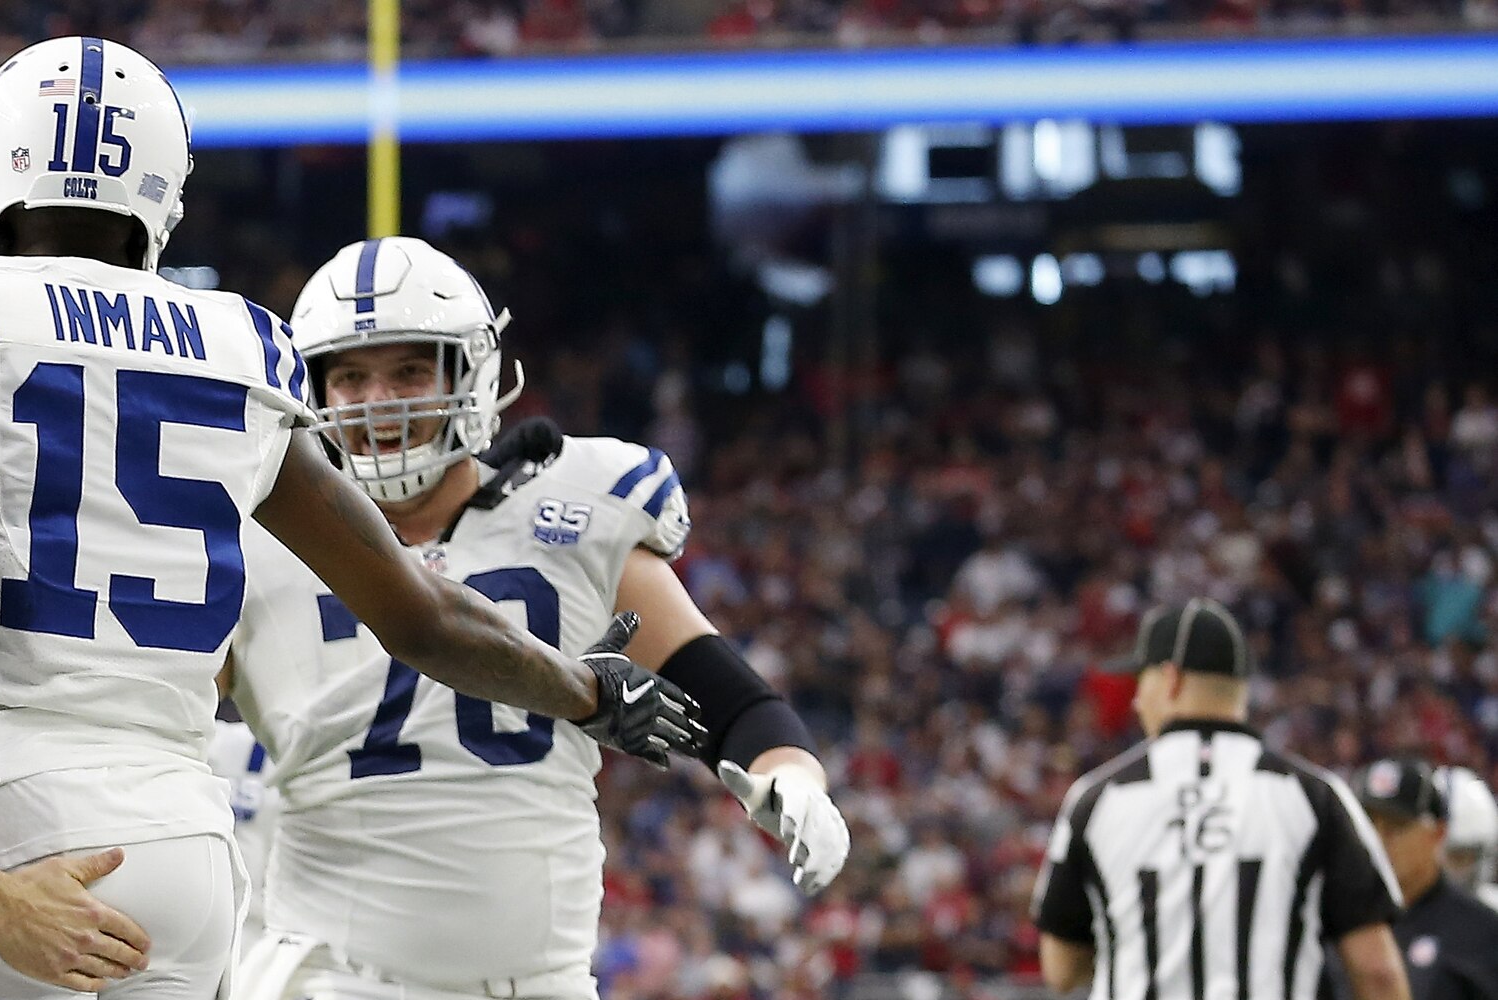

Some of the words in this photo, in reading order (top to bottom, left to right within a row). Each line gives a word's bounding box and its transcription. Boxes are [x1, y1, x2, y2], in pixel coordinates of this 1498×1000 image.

[48, 103, 136, 178] 15
[64, 177, 98, 200] COLTS
[44, 283, 207, 361] INMAN
[0, 361, 251, 654] 15
[535, 498, 593, 532] 35
[1164, 807, 1234, 857] 16
